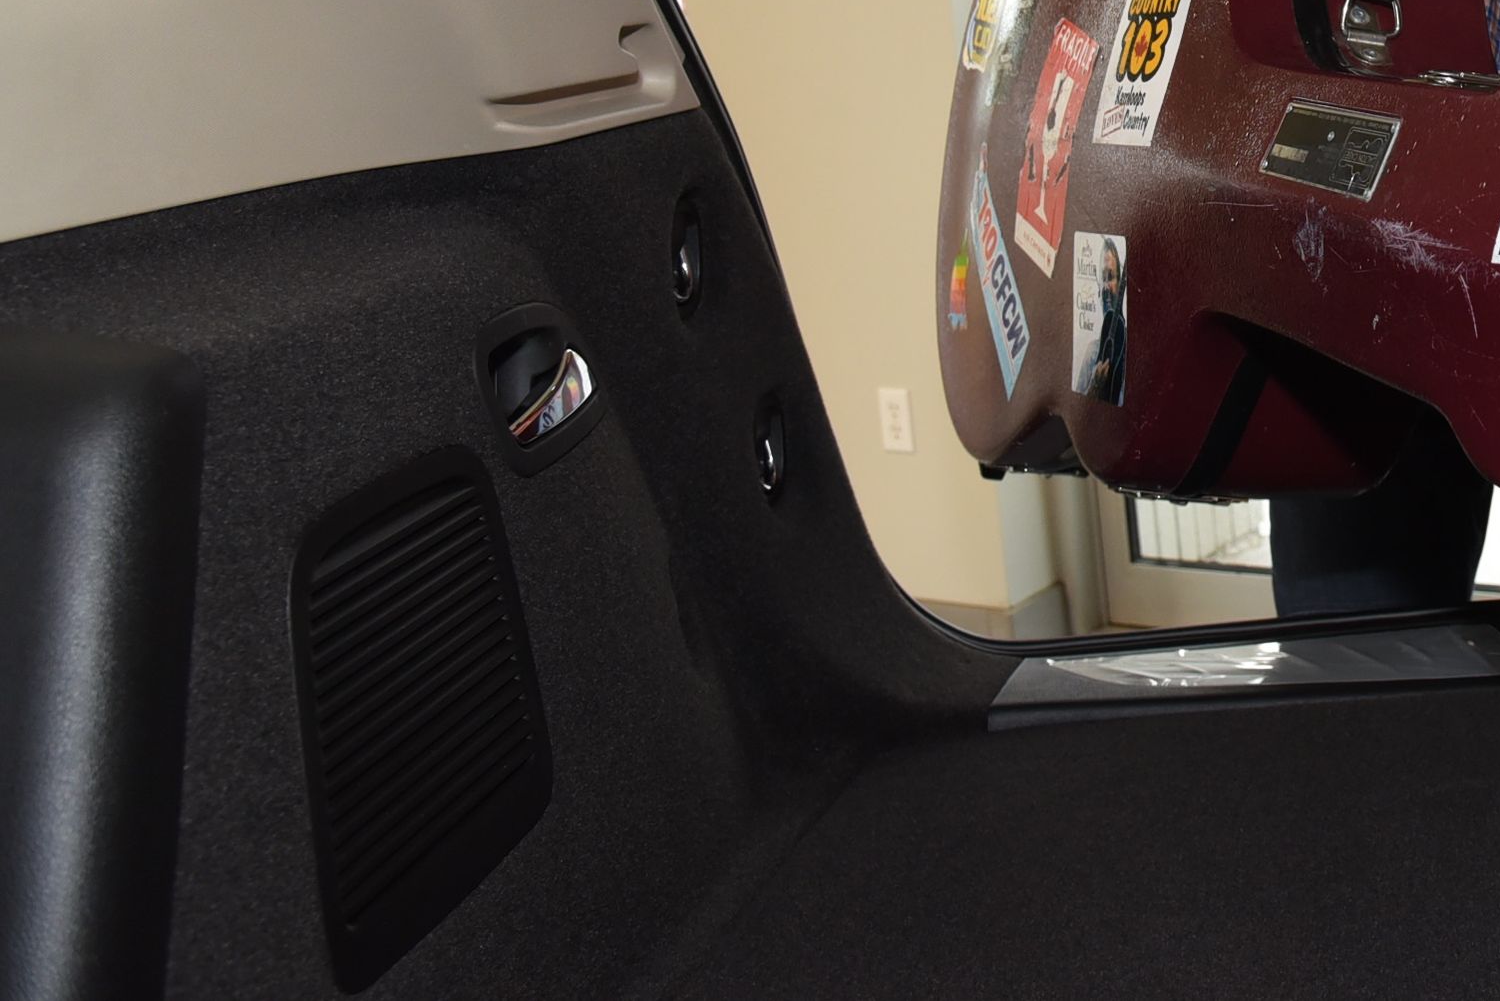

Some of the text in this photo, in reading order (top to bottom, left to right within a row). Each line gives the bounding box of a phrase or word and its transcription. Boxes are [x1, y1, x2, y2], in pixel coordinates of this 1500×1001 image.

[1117, 17, 1171, 81] 103
[1123, 111, 1149, 136] Country
[991, 254, 1027, 359] CFCW
